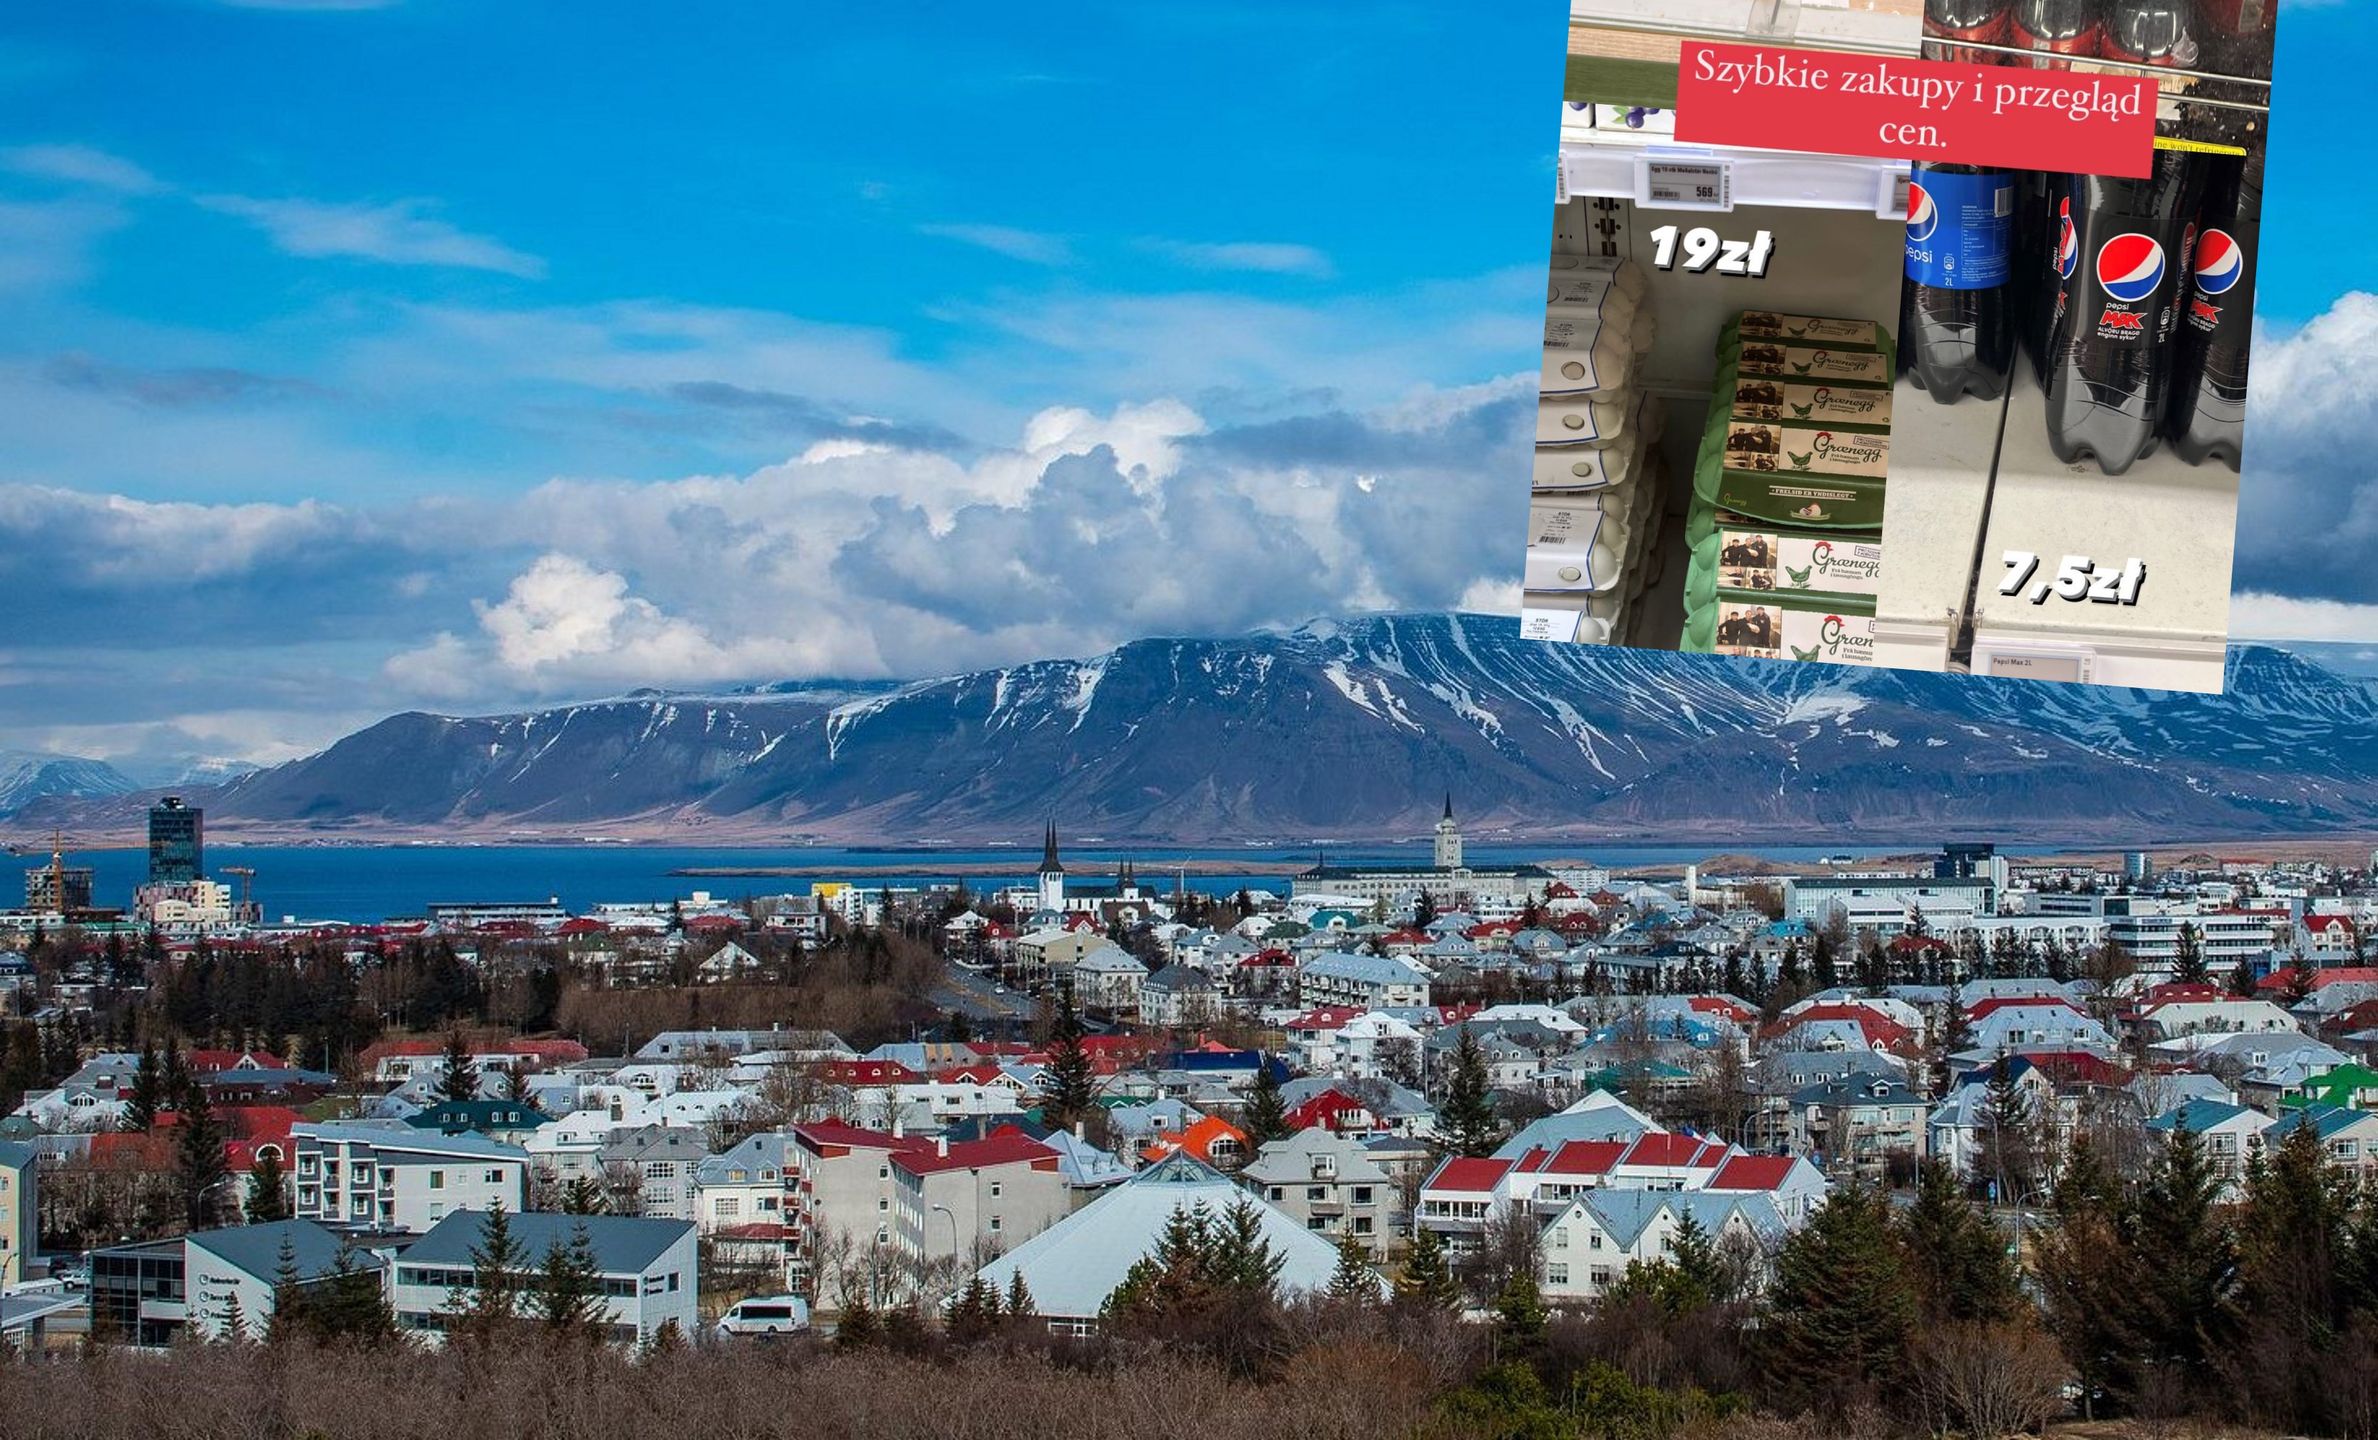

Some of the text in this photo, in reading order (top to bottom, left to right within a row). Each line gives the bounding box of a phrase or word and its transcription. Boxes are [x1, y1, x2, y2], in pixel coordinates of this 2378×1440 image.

[1696, 186, 1713, 198] 569
[2106, 302, 2129, 310] pepsi
[2099, 309, 2148, 329] MAX
[1814, 432, 1882, 463] Grænegg
[1993, 657, 2009, 666] Pepsi
